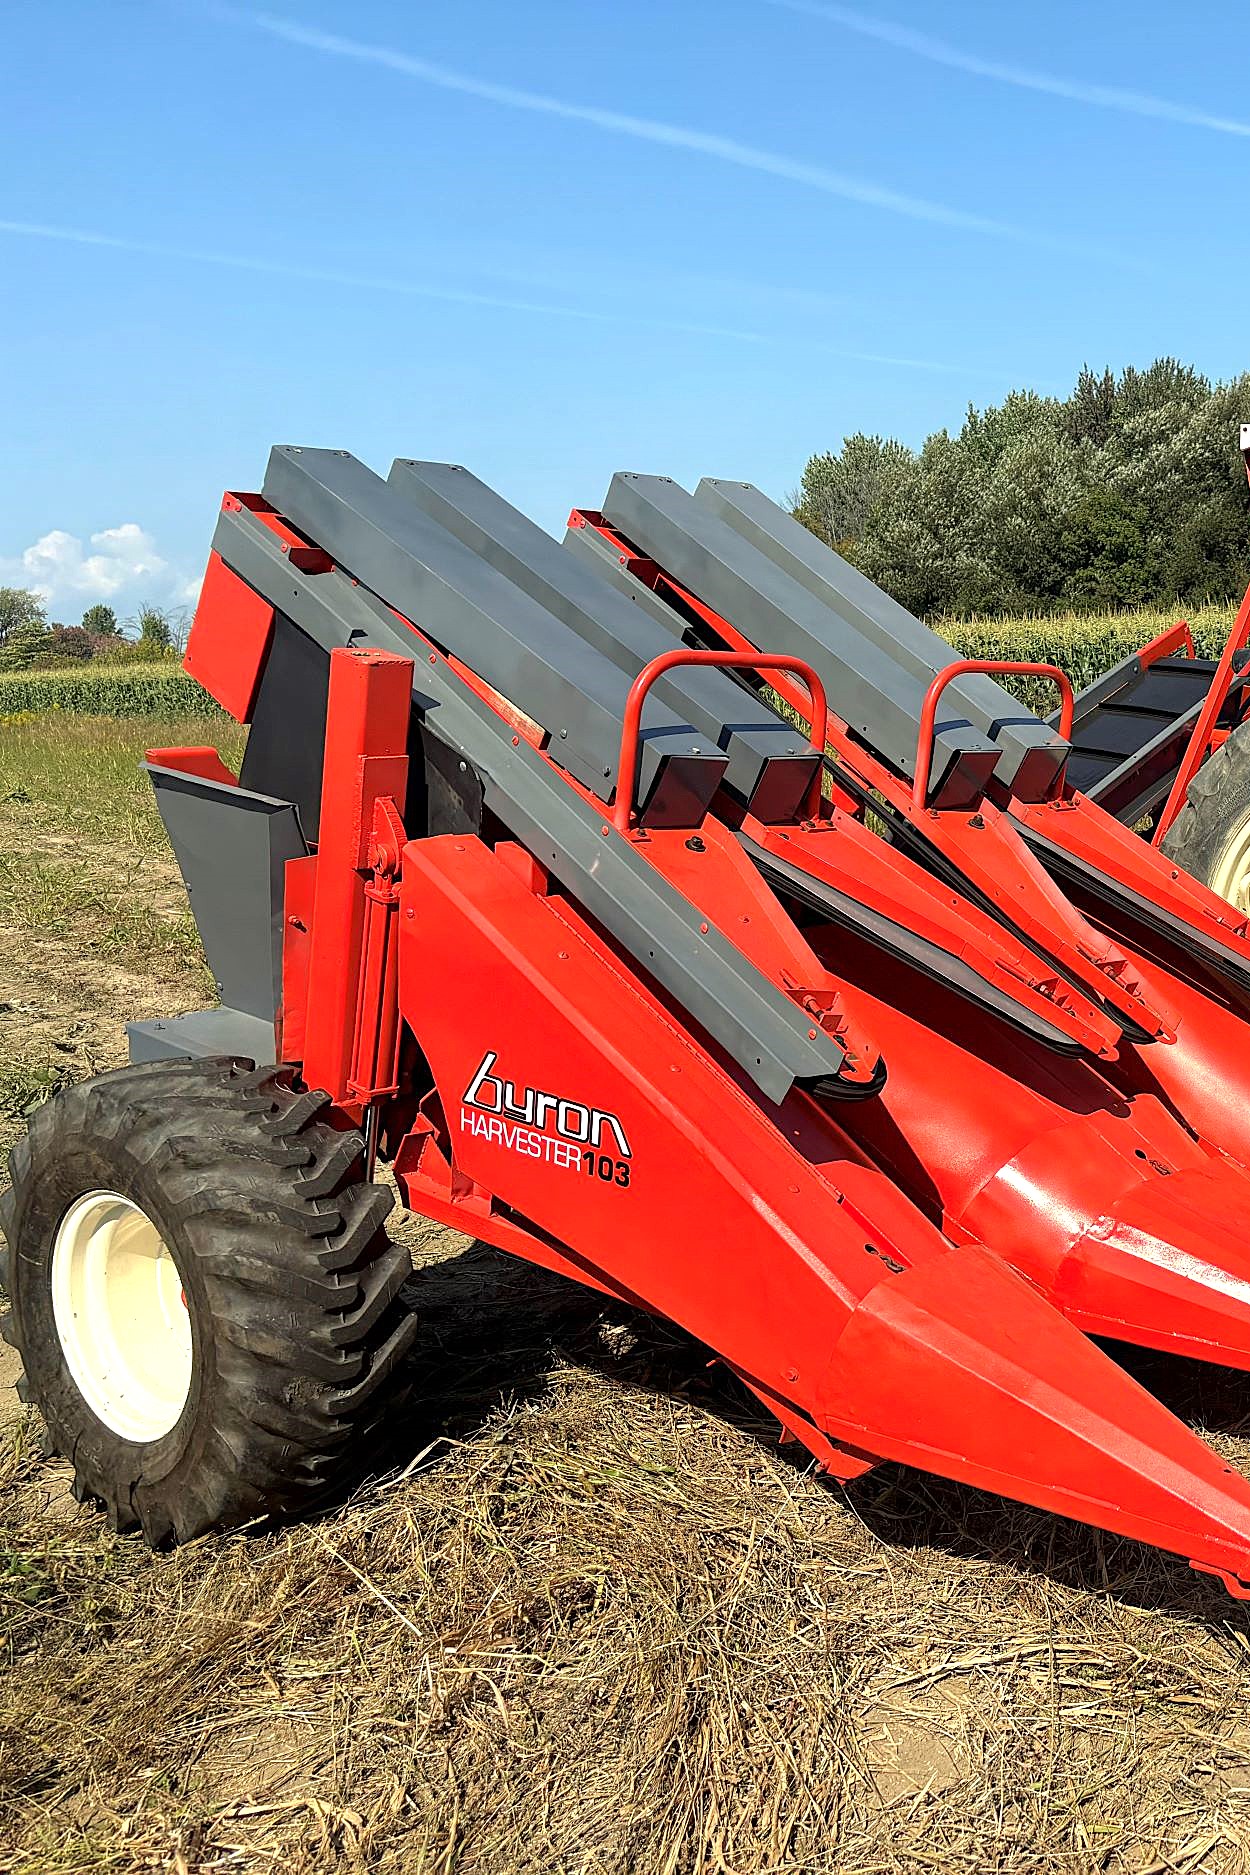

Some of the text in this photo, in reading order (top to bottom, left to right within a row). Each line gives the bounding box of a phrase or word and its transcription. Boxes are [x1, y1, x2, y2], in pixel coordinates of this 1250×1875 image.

[460, 1107, 631, 1188] HARVESTER 103
[462, 1051, 632, 1158] byron
